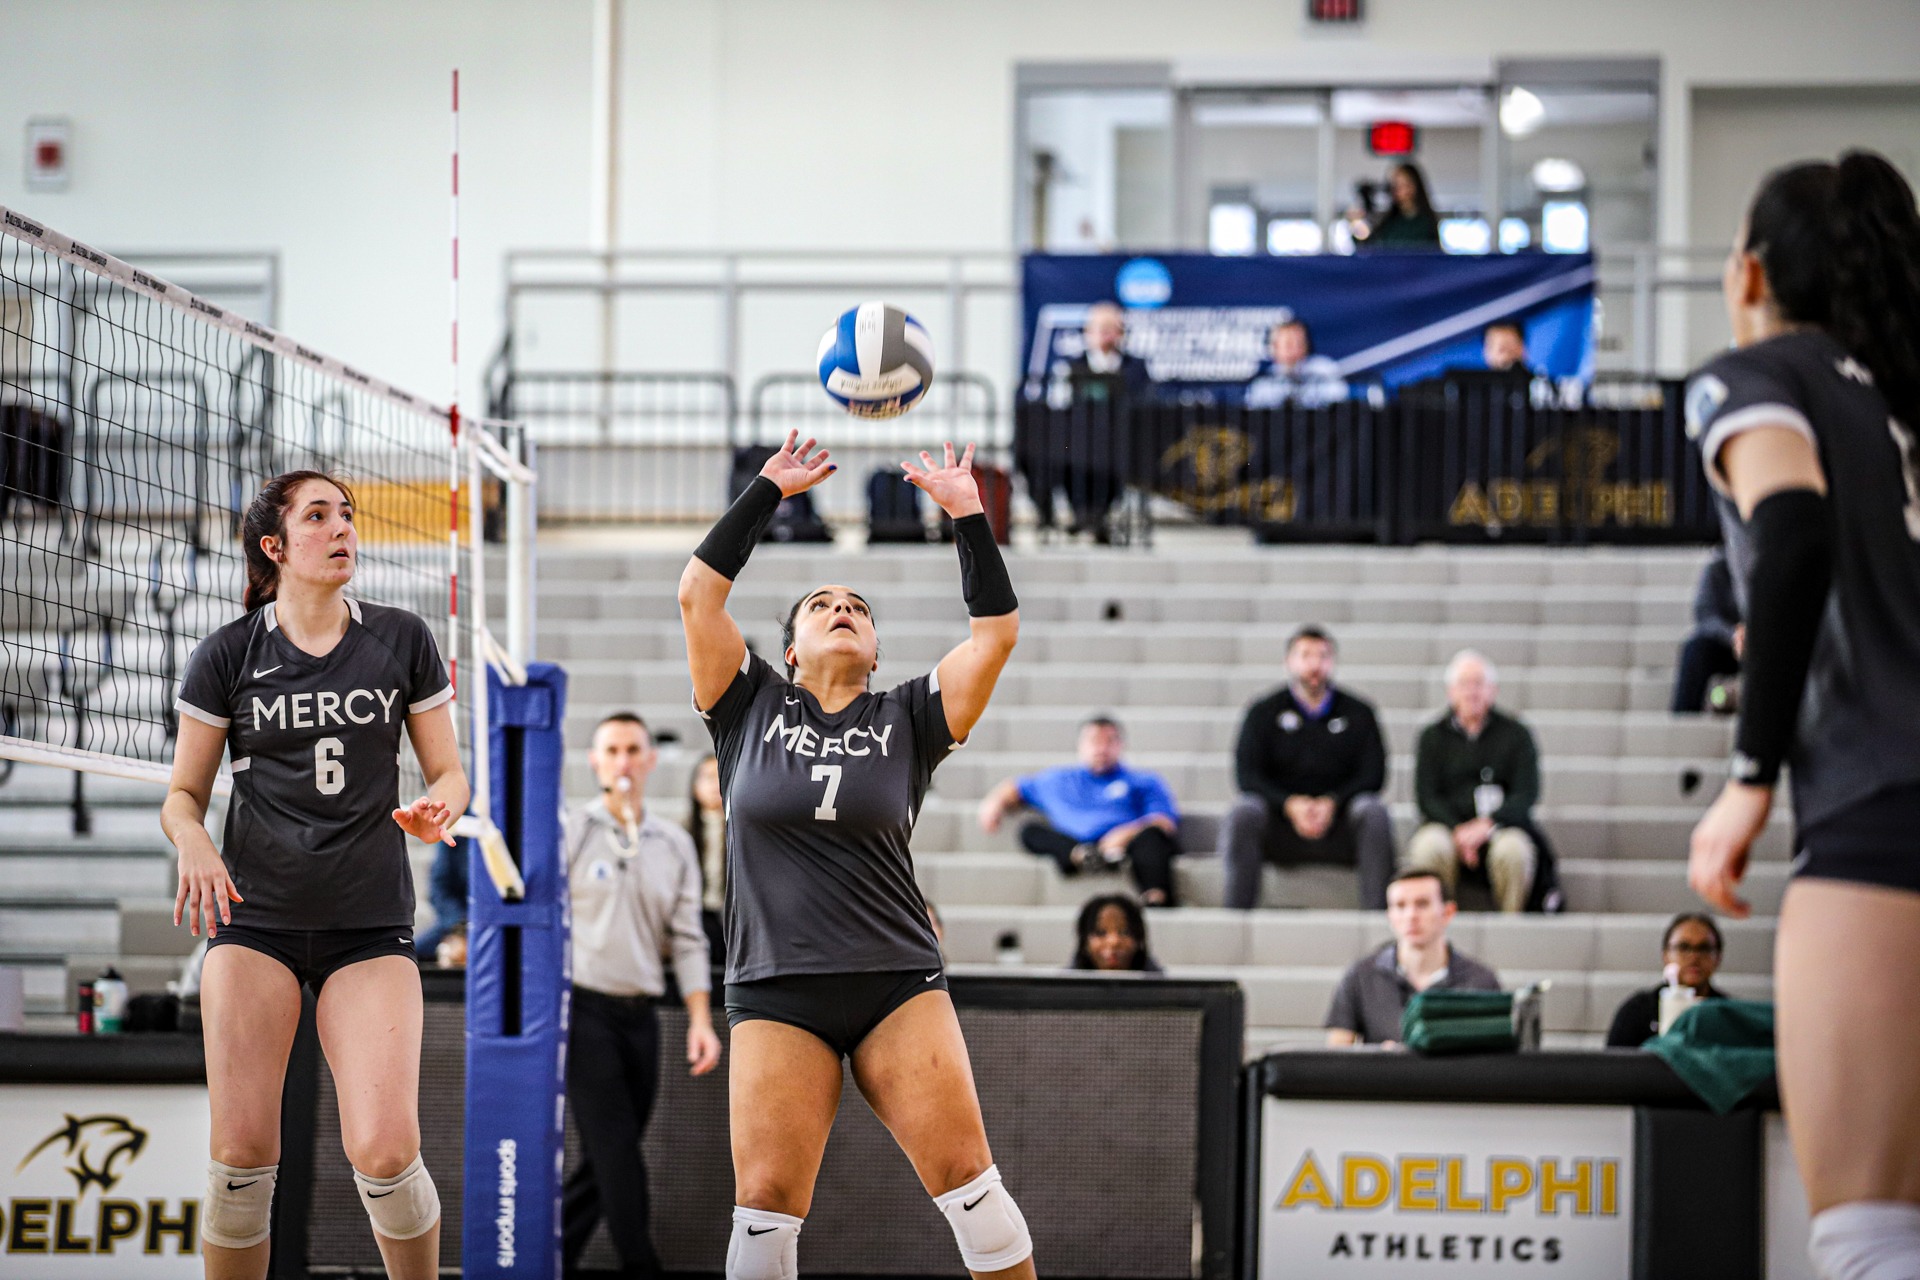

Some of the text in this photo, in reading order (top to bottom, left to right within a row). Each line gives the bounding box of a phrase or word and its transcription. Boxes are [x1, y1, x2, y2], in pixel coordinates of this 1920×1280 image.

[1449, 481, 1676, 527] ADEPHI
[252, 688, 400, 731] MERCY
[763, 713, 893, 758] MERCY
[314, 737, 346, 795] 6
[811, 764, 842, 821] 7
[1275, 1149, 1621, 1217] ADELPHI
[0, 1196, 203, 1256] ELPH
[1330, 1232, 1562, 1262] ATHLETICS
